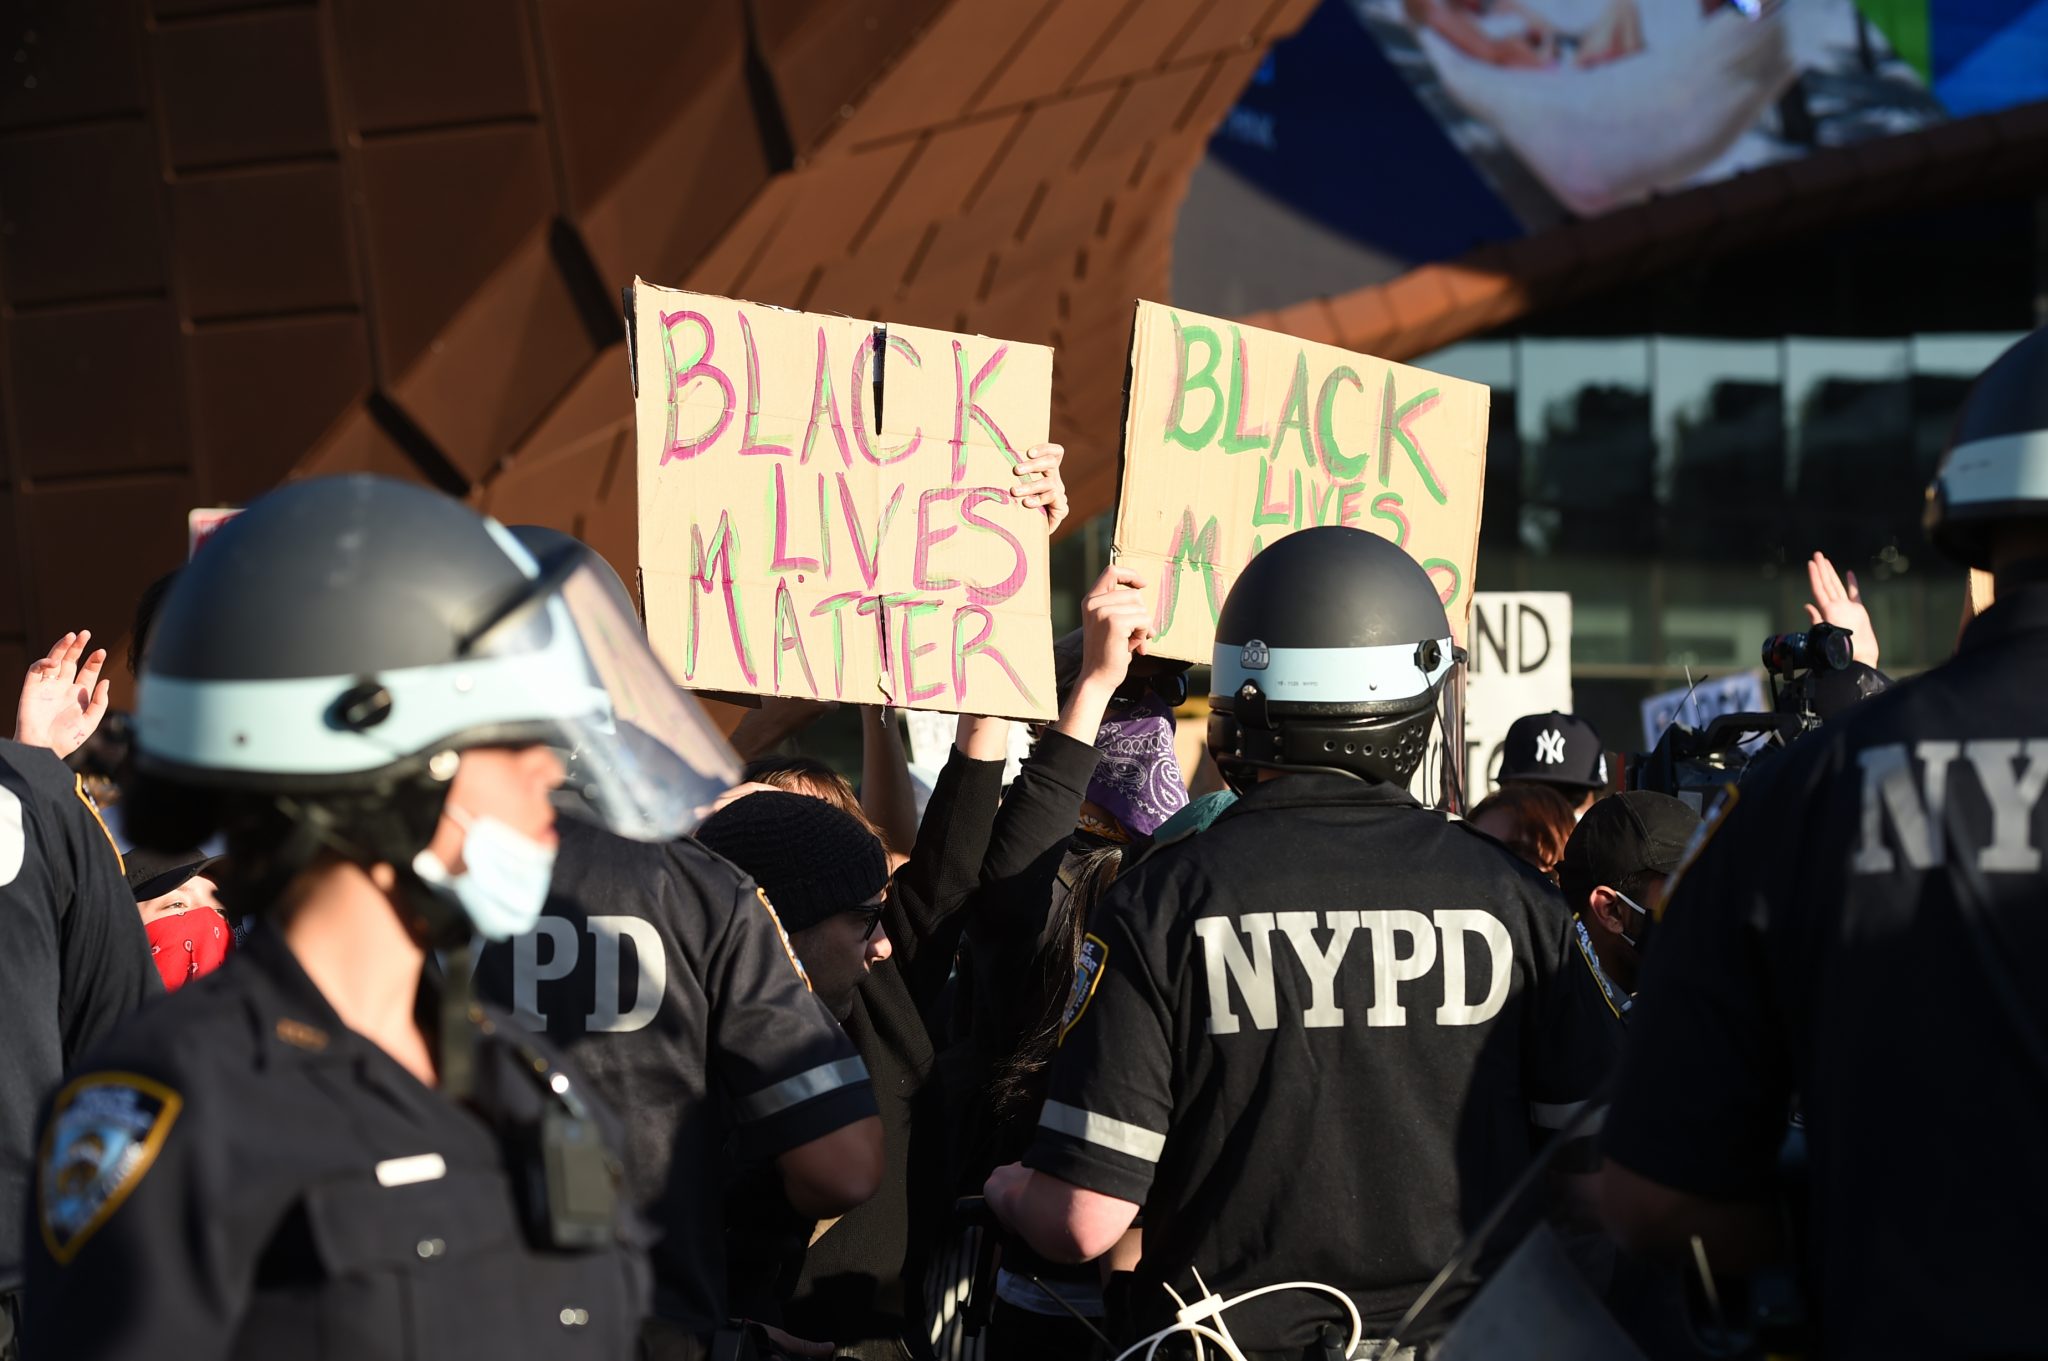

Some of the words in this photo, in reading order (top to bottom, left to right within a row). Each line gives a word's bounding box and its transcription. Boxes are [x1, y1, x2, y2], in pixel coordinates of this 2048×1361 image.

[660, 310, 1046, 512] BLACK
[1163, 311, 1448, 505] BLACK
[768, 463, 1028, 605] LIVES
[1251, 456, 1411, 545] LIVES
[685, 509, 1039, 708] MATTER
[1243, 649, 1267, 662] DOT
[1467, 603, 1551, 674] ND
[1535, 729, 1566, 764] NY
[478, 915, 667, 1033] PD
[1195, 909, 1513, 1035] NYPD
